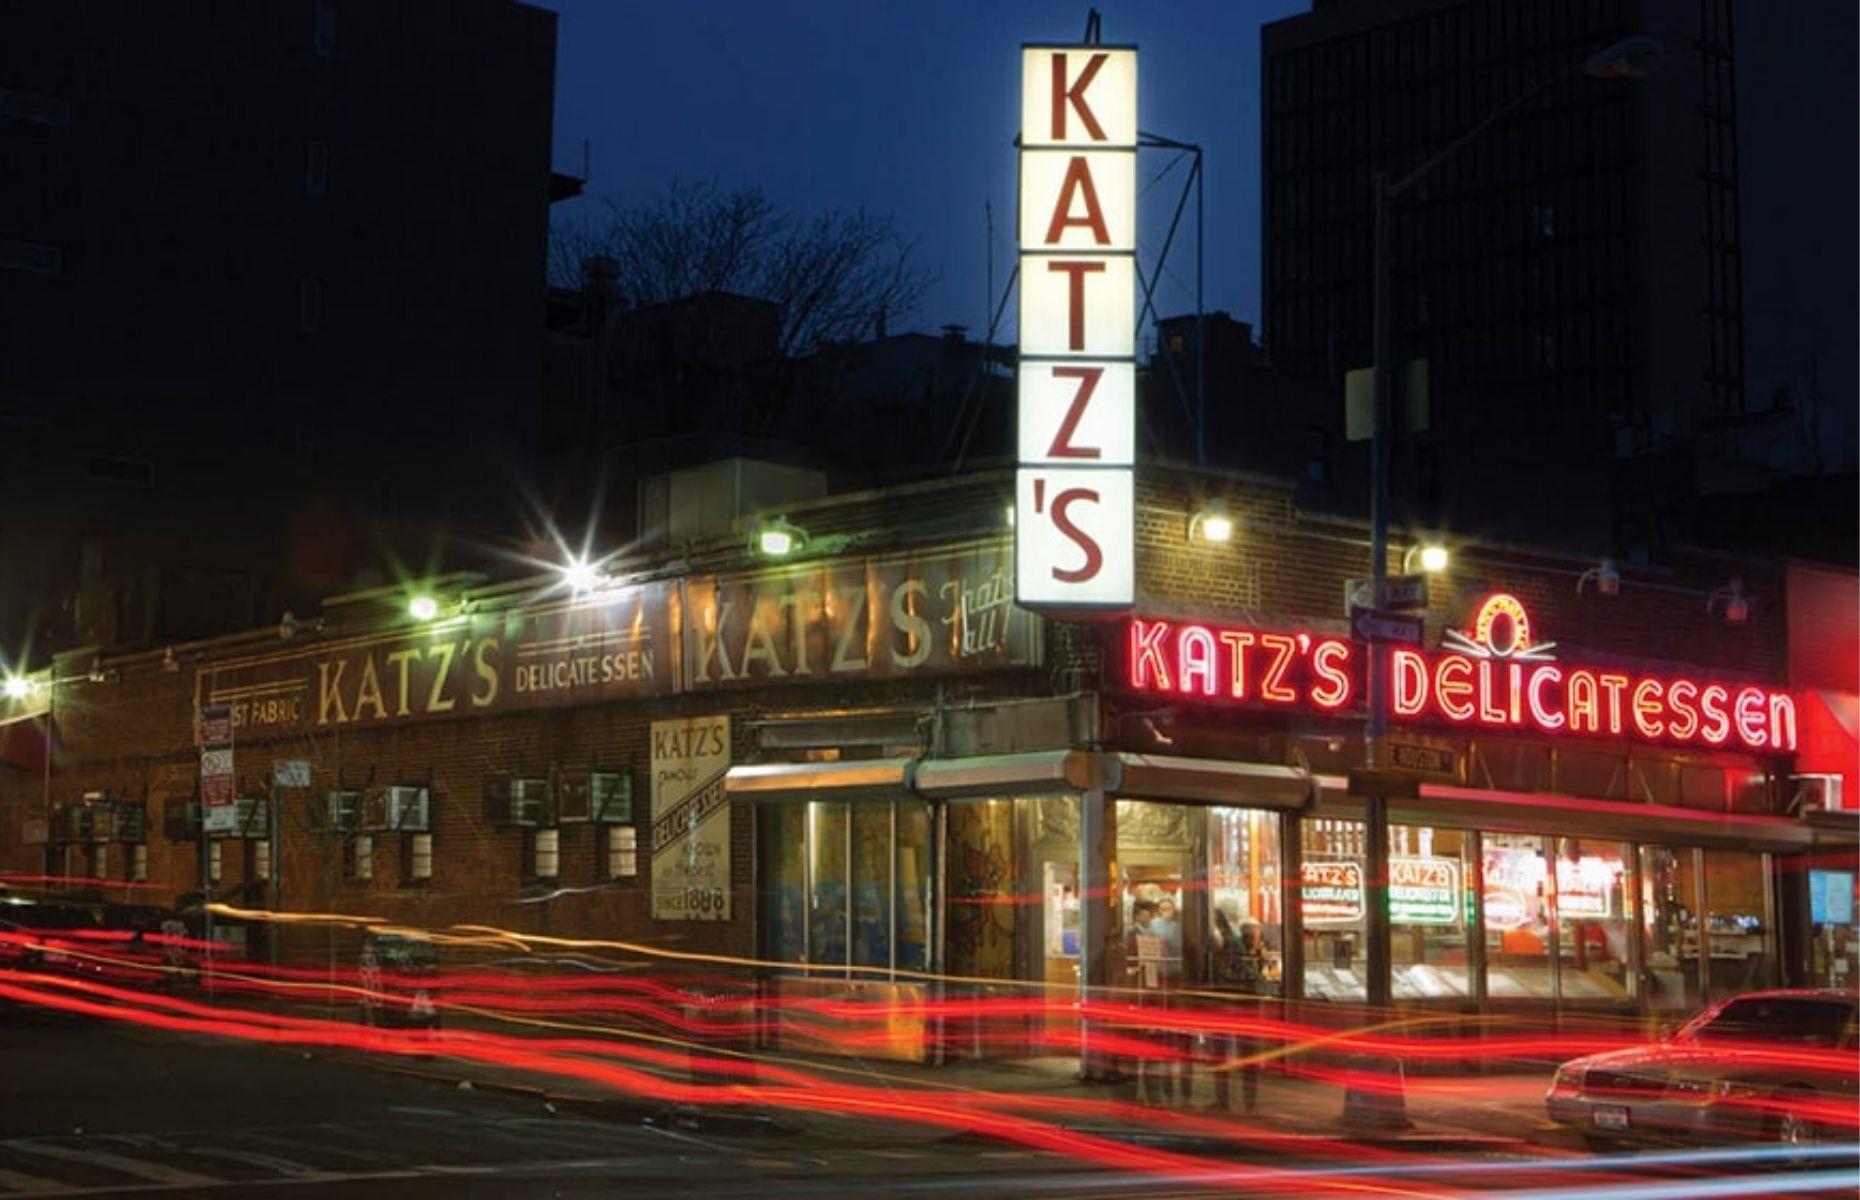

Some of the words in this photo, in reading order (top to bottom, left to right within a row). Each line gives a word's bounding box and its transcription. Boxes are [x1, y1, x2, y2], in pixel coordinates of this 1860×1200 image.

[1033, 53, 1112, 584] KATZ'S
[515, 651, 655, 693] DELICATESSEN
[694, 579, 933, 682] KATZ'S
[1131, 620, 1349, 706] KATZ'S
[253, 699, 299, 724] FABRIC
[317, 638, 500, 726] KATZ'S
[655, 724, 724, 760] KATZ'S
